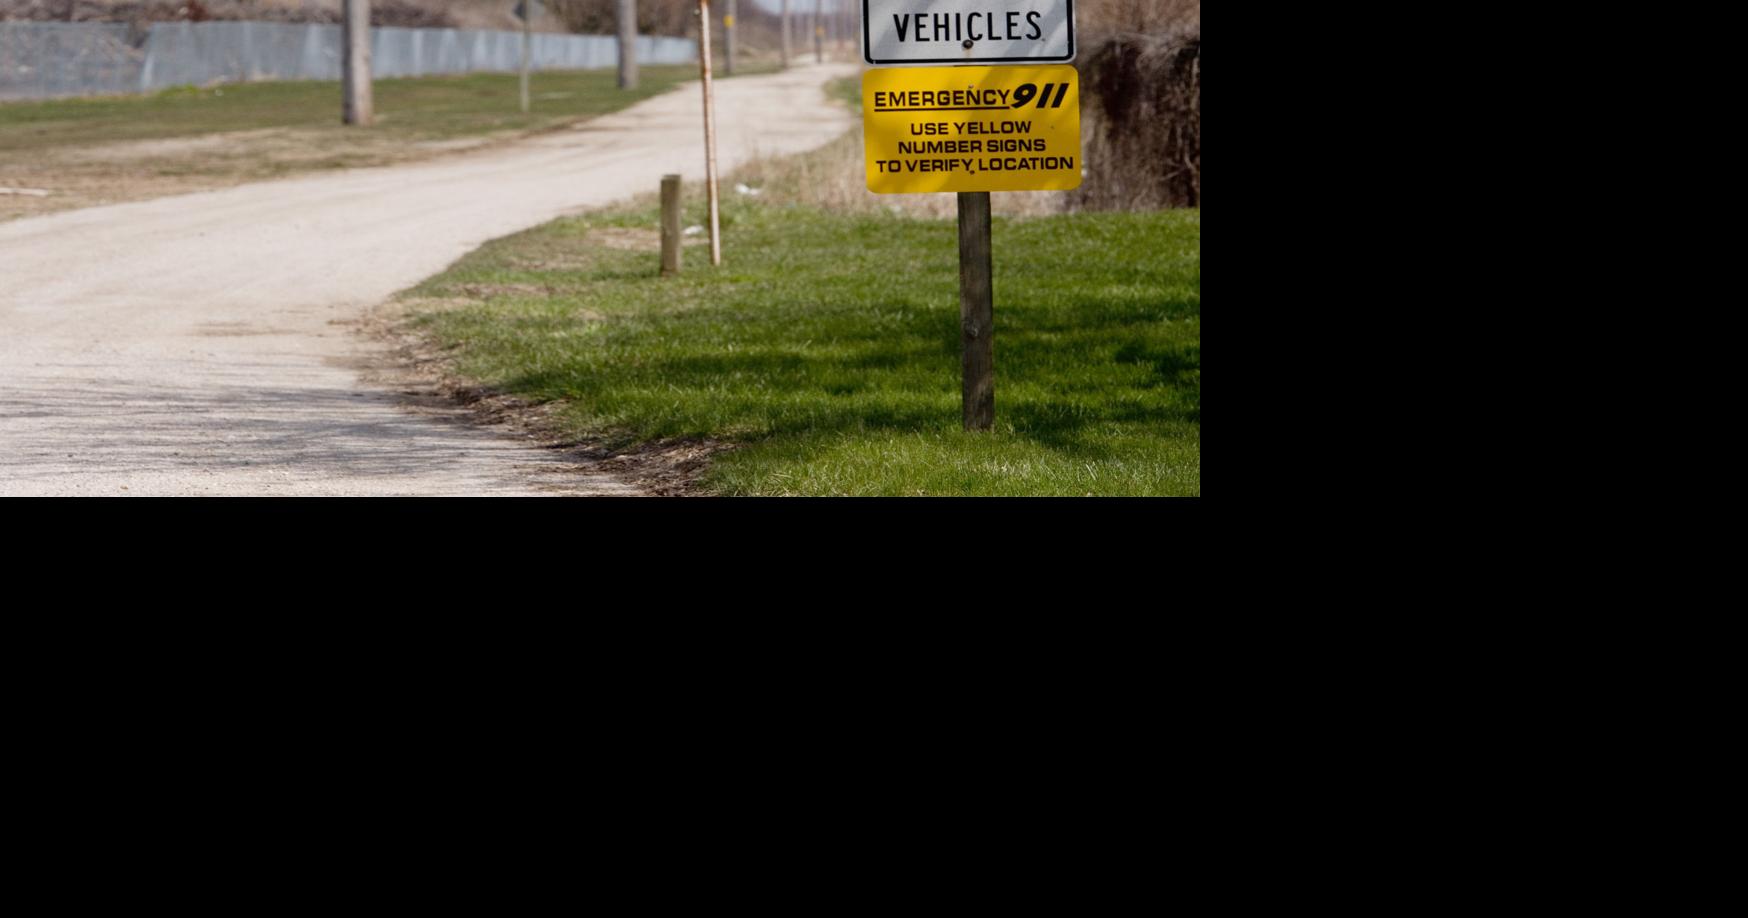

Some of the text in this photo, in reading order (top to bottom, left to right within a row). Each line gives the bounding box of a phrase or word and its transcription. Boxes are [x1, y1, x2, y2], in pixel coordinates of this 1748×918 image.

[893, 11, 1042, 42] VEHICLES
[874, 83, 1070, 109] EMERGENCY 911
[911, 121, 1032, 136] USE YELLOW
[898, 139, 1046, 154] NUMBER SIGNS
[876, 157, 1074, 173] TO VERIFY LOCATION
